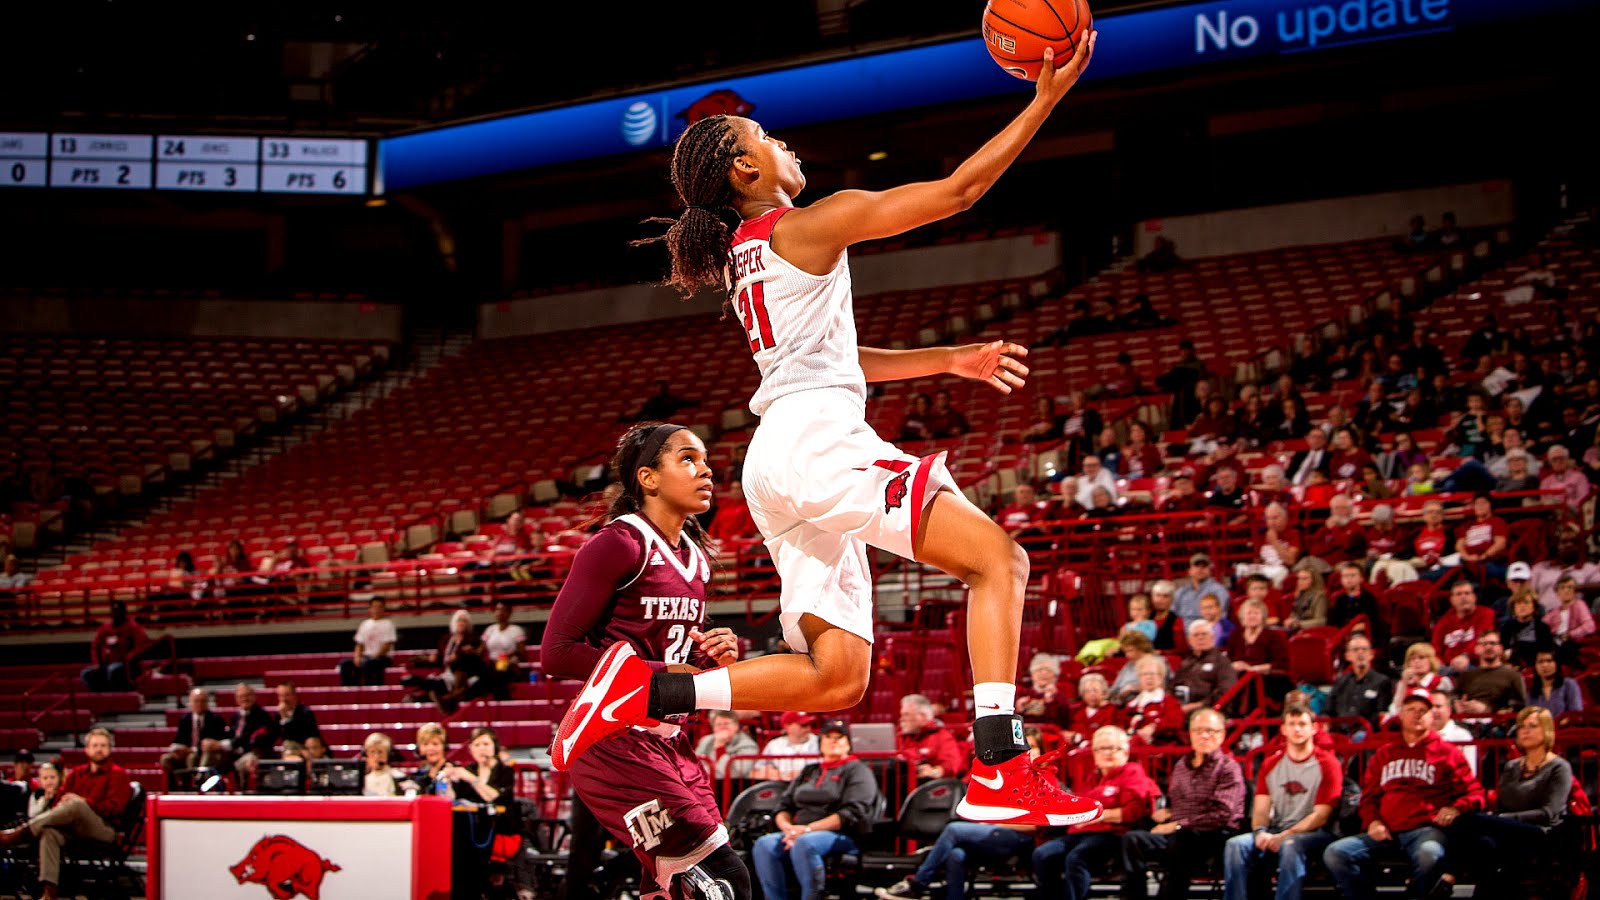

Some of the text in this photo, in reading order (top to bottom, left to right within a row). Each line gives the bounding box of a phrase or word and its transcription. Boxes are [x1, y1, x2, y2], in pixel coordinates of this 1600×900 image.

[1196, 0, 1449, 53] No update
[60, 138, 77, 153] 13
[163, 140, 186, 156] 24
[269, 142, 290, 159] 33
[11, 163, 26, 183] 0
[71, 165, 131, 185] PTS 2
[177, 167, 237, 187] PTS 3
[286, 170, 346, 189] PTS 6
[729, 245, 766, 280] SPER
[738, 280, 777, 353] 21
[640, 596, 699, 621] TEXAS
[1380, 758, 1436, 786] ARKANSAS
